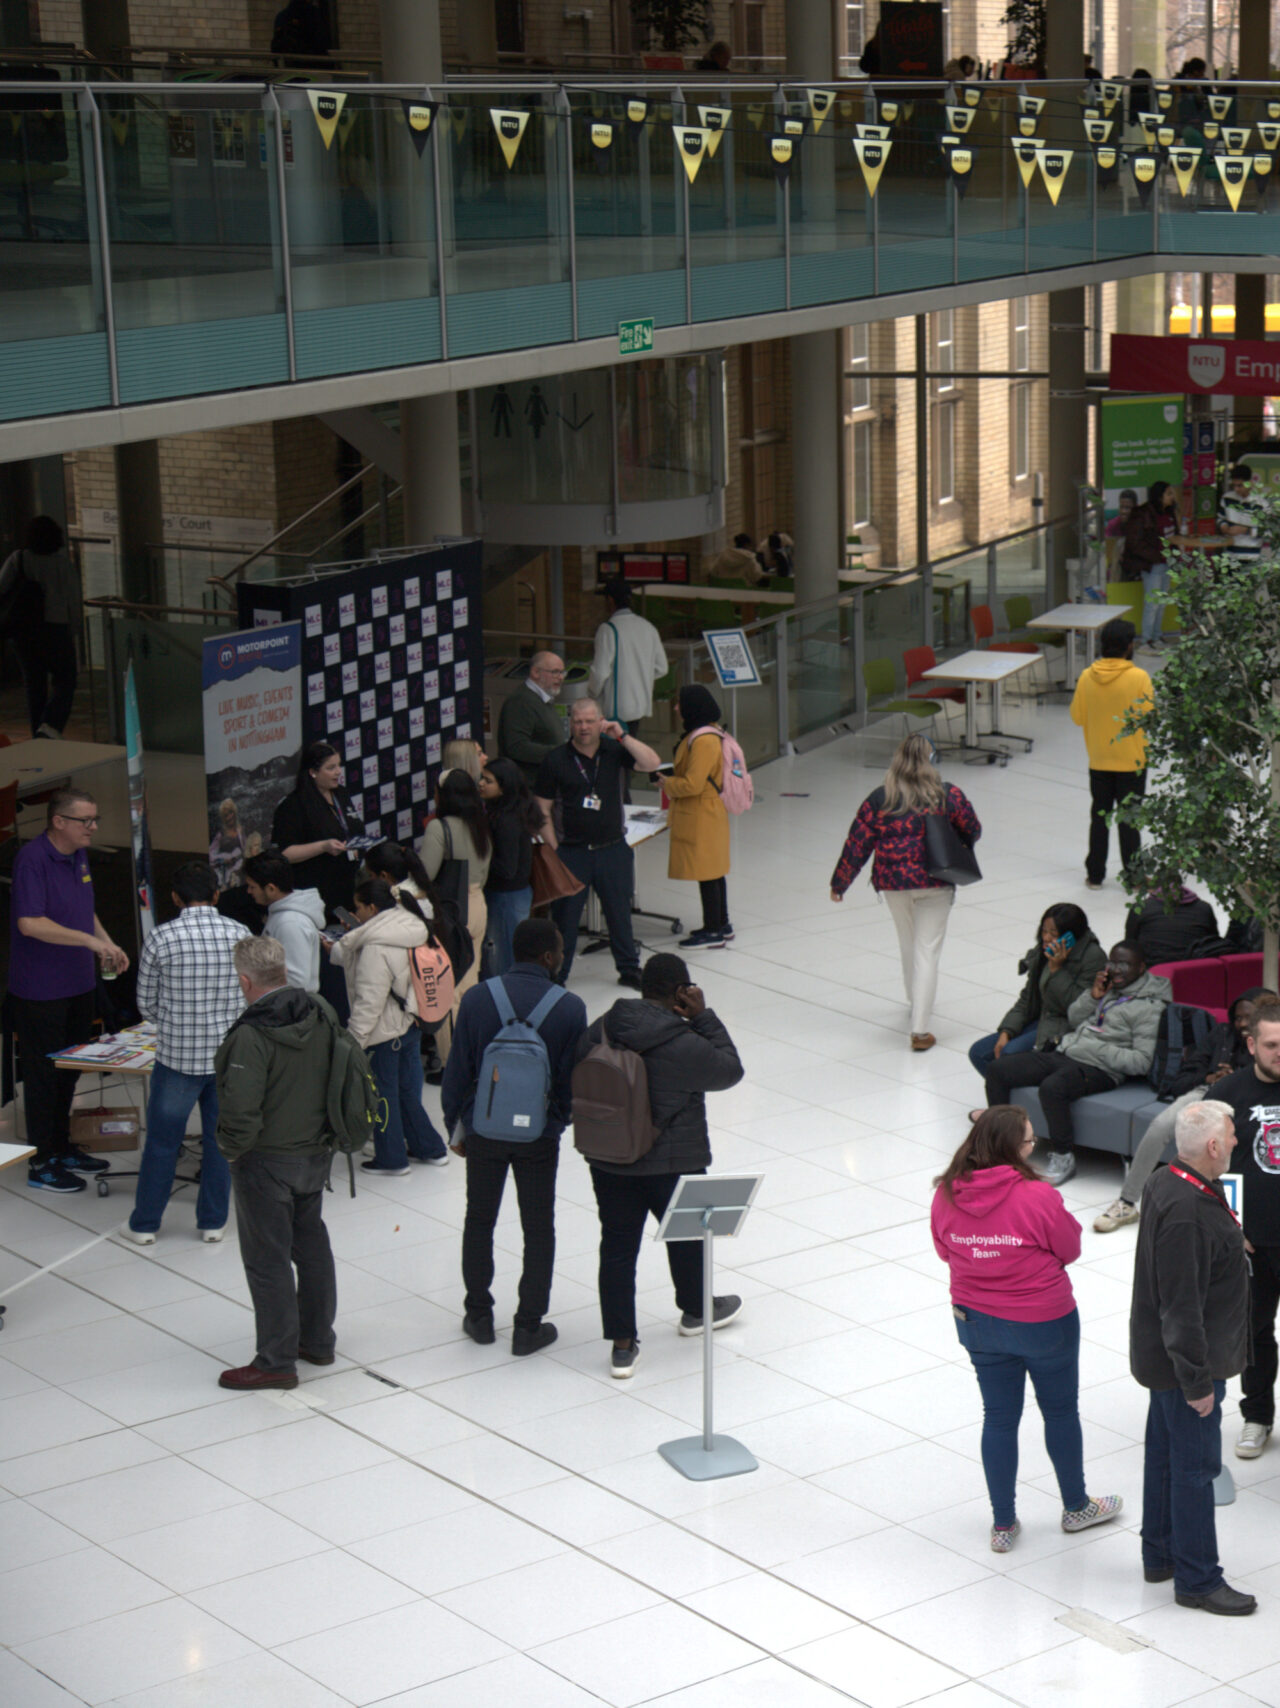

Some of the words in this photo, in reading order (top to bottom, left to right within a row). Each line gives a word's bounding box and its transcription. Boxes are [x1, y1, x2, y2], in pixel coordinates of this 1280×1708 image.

[621, 326, 633, 339] Fire
[621, 339, 633, 351] exit
[1193, 355, 1221, 366] NTU
[179, 517, 211, 531] Court
[237, 635, 290, 654] MOTORPOINT
[221, 650, 233, 662] m
[218, 698, 234, 715] LIVE
[236, 694, 262, 712] MUSIC,
[264, 686, 293, 705] EVENTS
[223, 715, 247, 735] SPORT
[249, 715, 255, 728] &
[258, 706, 291, 726] COMEDY
[228, 739, 236, 753] IN
[239, 725, 287, 750] NOTTINGHAM
[422, 967, 438, 1008] DEEDAT
[950, 1233, 1023, 1247] Employability
[971, 1248, 1000, 1259] Team
